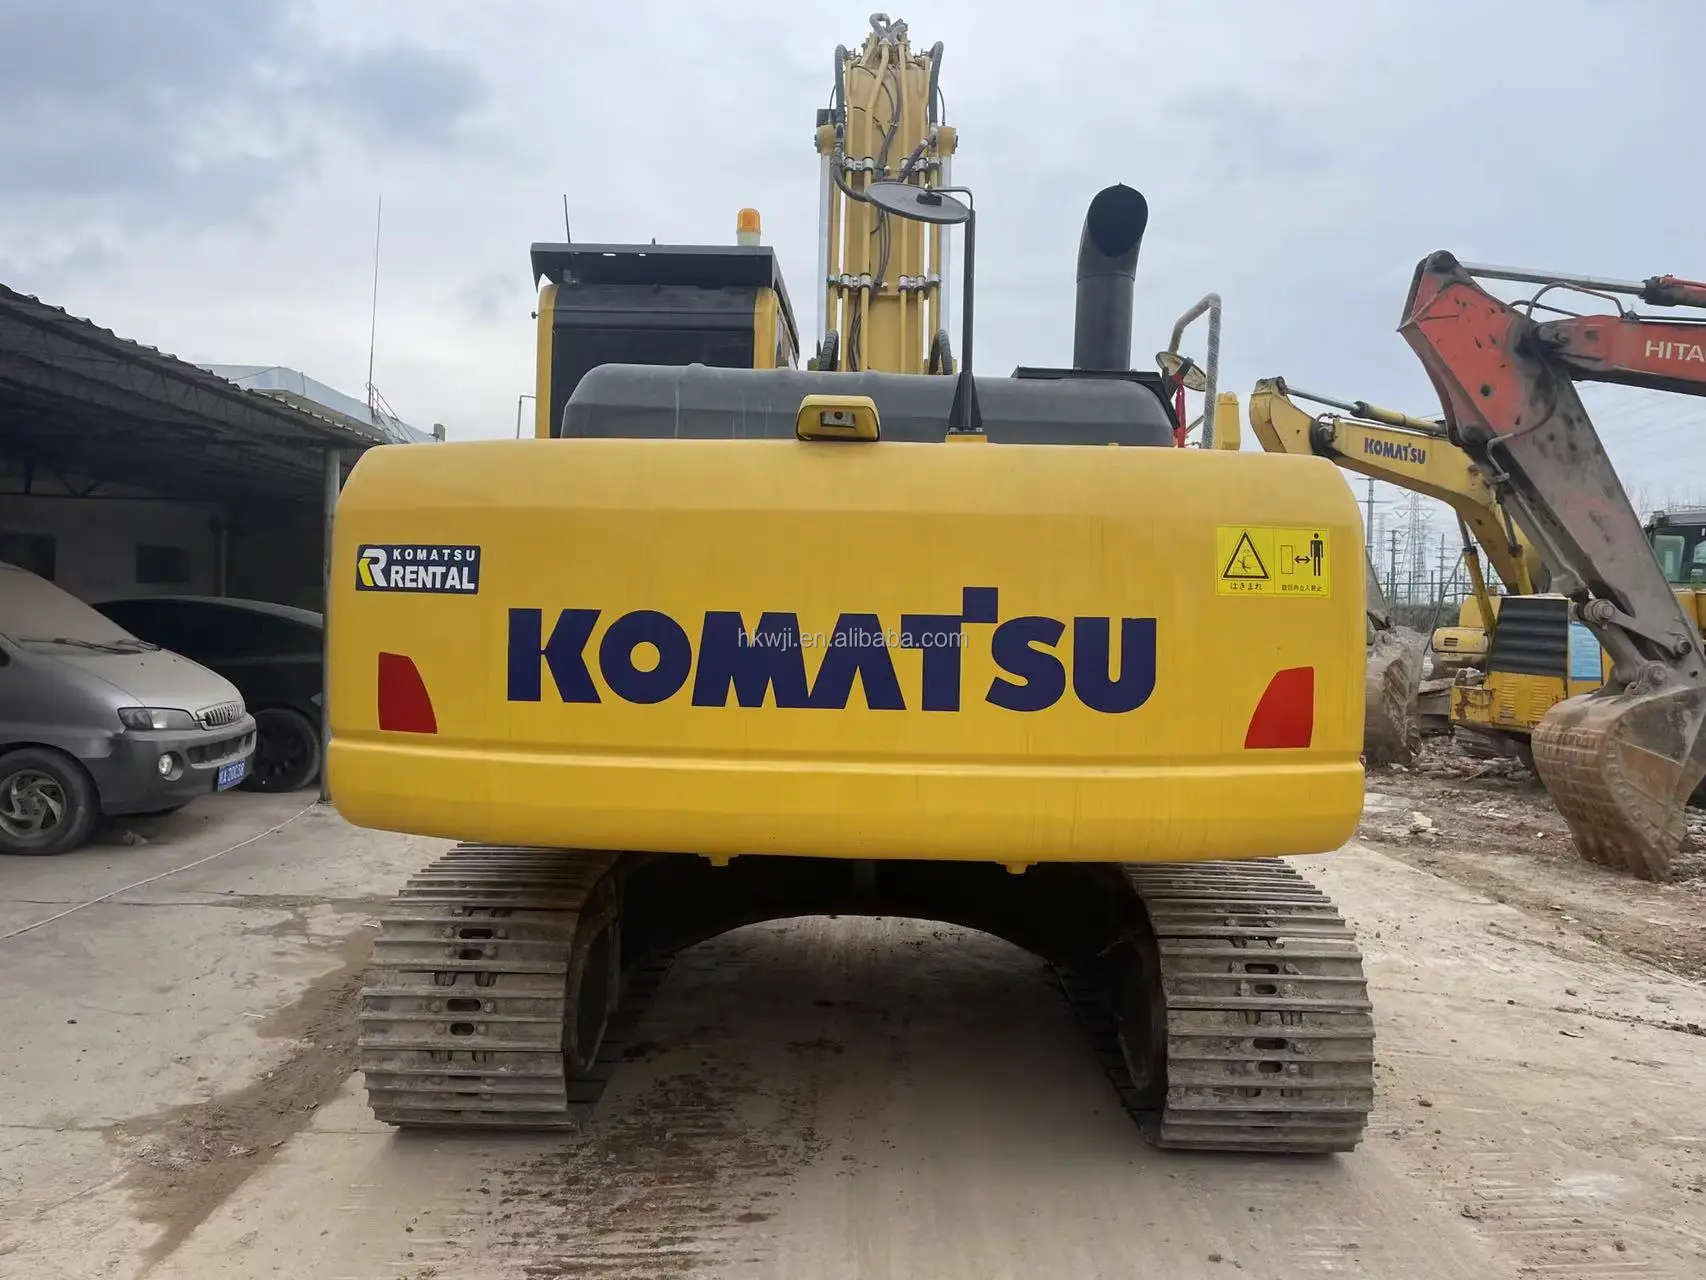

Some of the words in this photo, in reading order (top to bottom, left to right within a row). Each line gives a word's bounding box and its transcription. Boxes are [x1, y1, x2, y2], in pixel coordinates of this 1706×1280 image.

[1645, 339, 1706, 363] HITA
[1364, 436, 1426, 464] KOMATSU
[392, 548, 476, 561] KOMATSU
[389, 565, 475, 590] RENTAL
[507, 586, 1157, 714] KOMATSU
